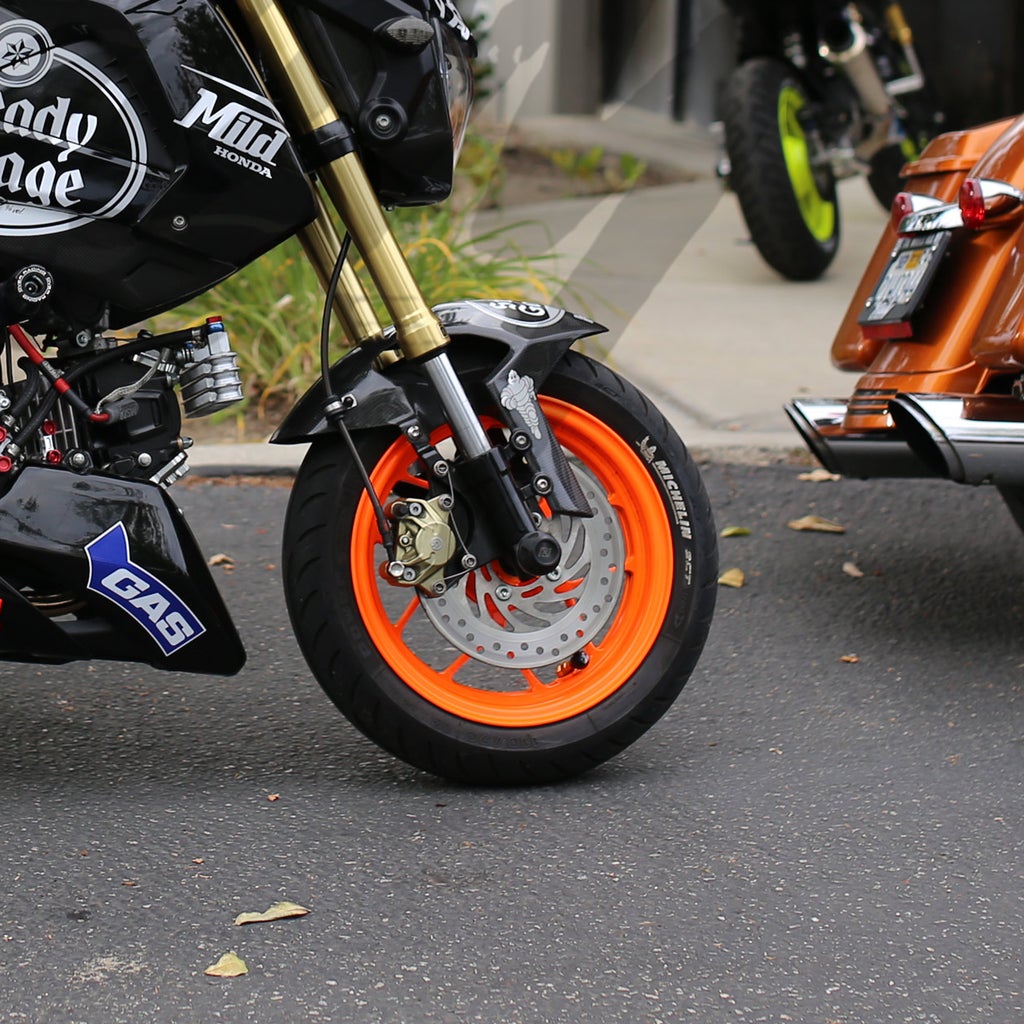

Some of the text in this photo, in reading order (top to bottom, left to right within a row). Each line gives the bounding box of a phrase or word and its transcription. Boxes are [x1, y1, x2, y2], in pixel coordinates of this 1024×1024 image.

[173, 87, 290, 167] Mild
[213, 145, 273, 179] HONDA
[655, 459, 693, 541] MICHELIN
[101, 568, 195, 646] GAS
